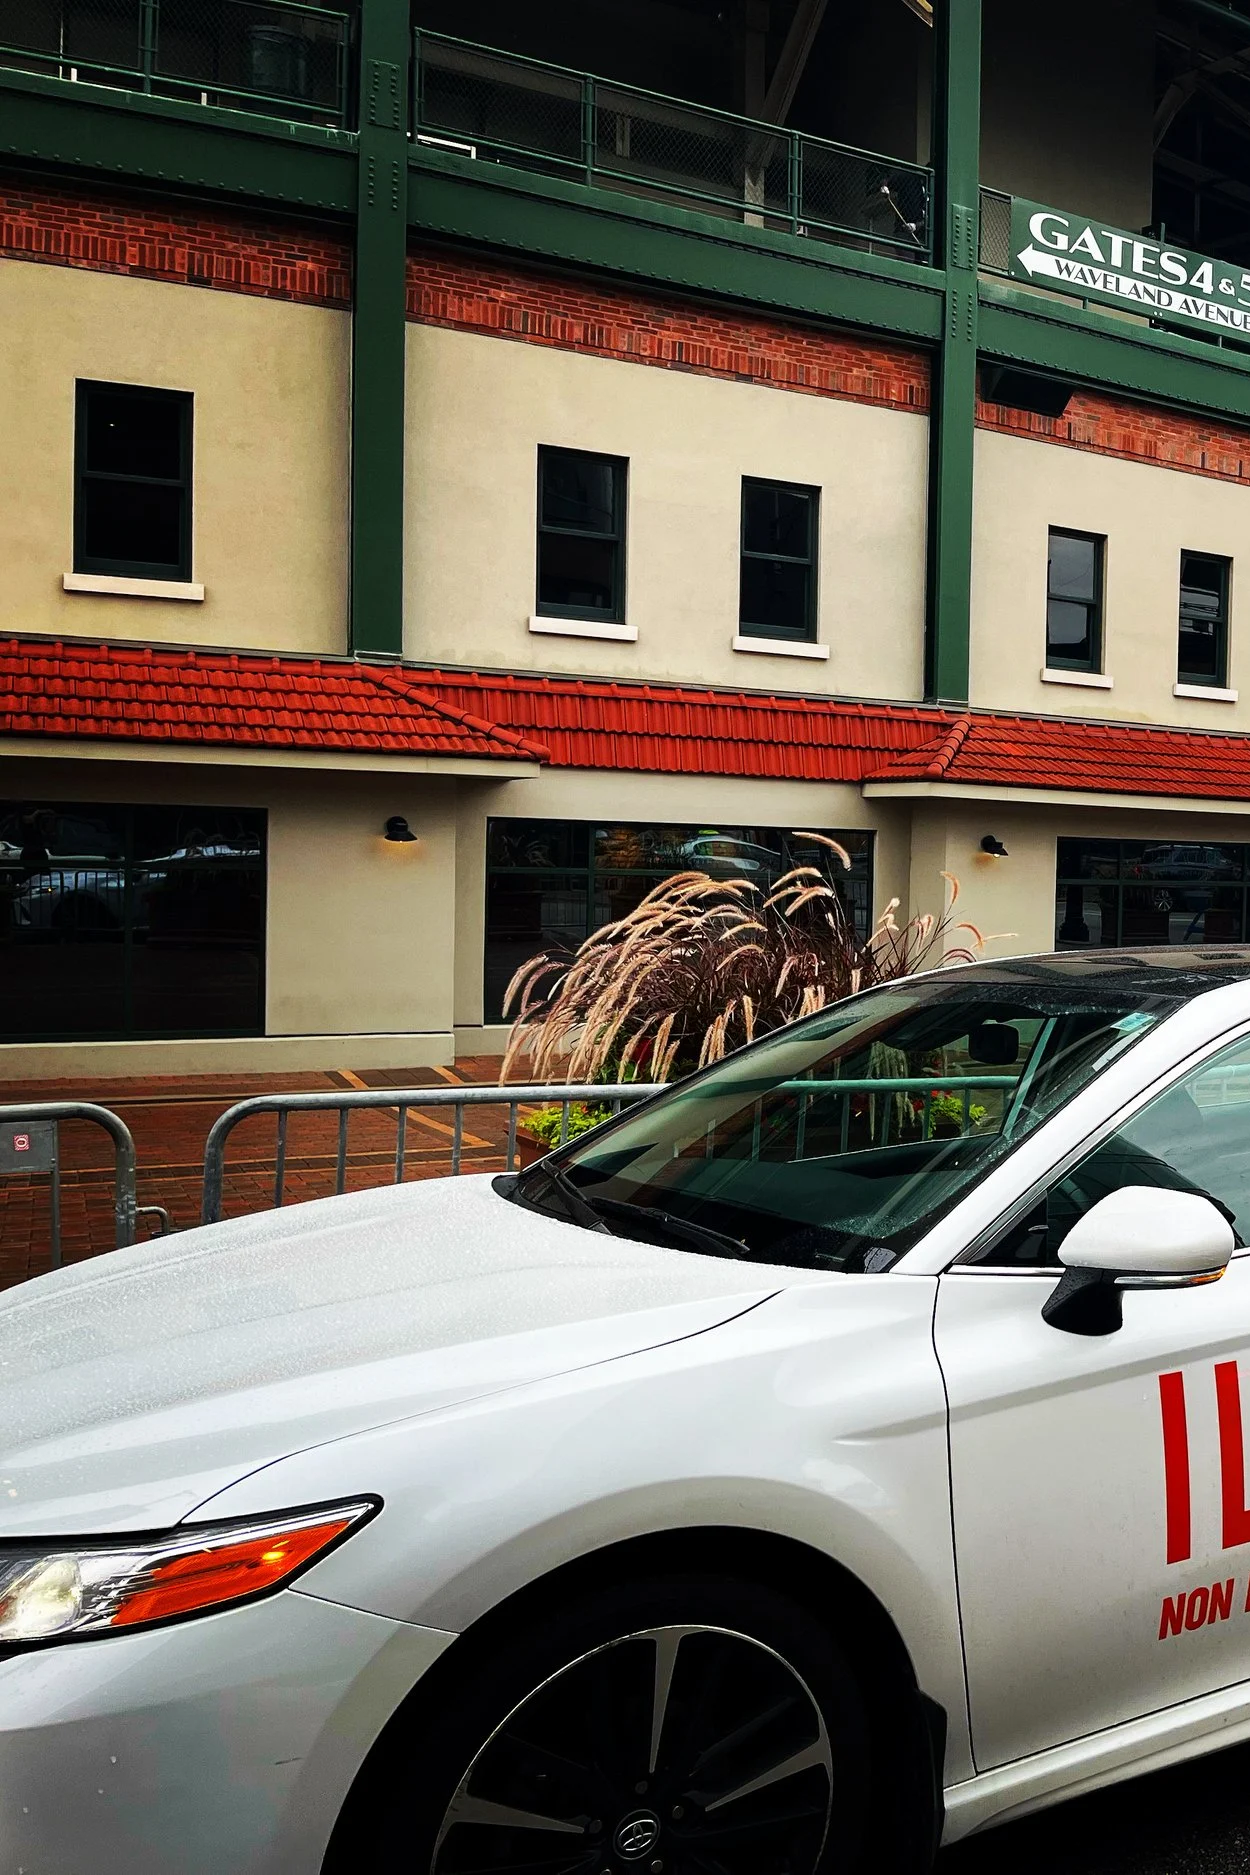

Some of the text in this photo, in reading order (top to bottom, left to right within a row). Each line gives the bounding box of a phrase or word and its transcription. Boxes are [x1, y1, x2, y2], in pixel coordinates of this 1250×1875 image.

[1028, 211, 1189, 288] GATES
[1188, 259, 1214, 295] 4
[1218, 277, 1236, 297] &
[1054, 258, 1174, 308] WAVELAND
[1158, 1577, 1235, 1641] NON
